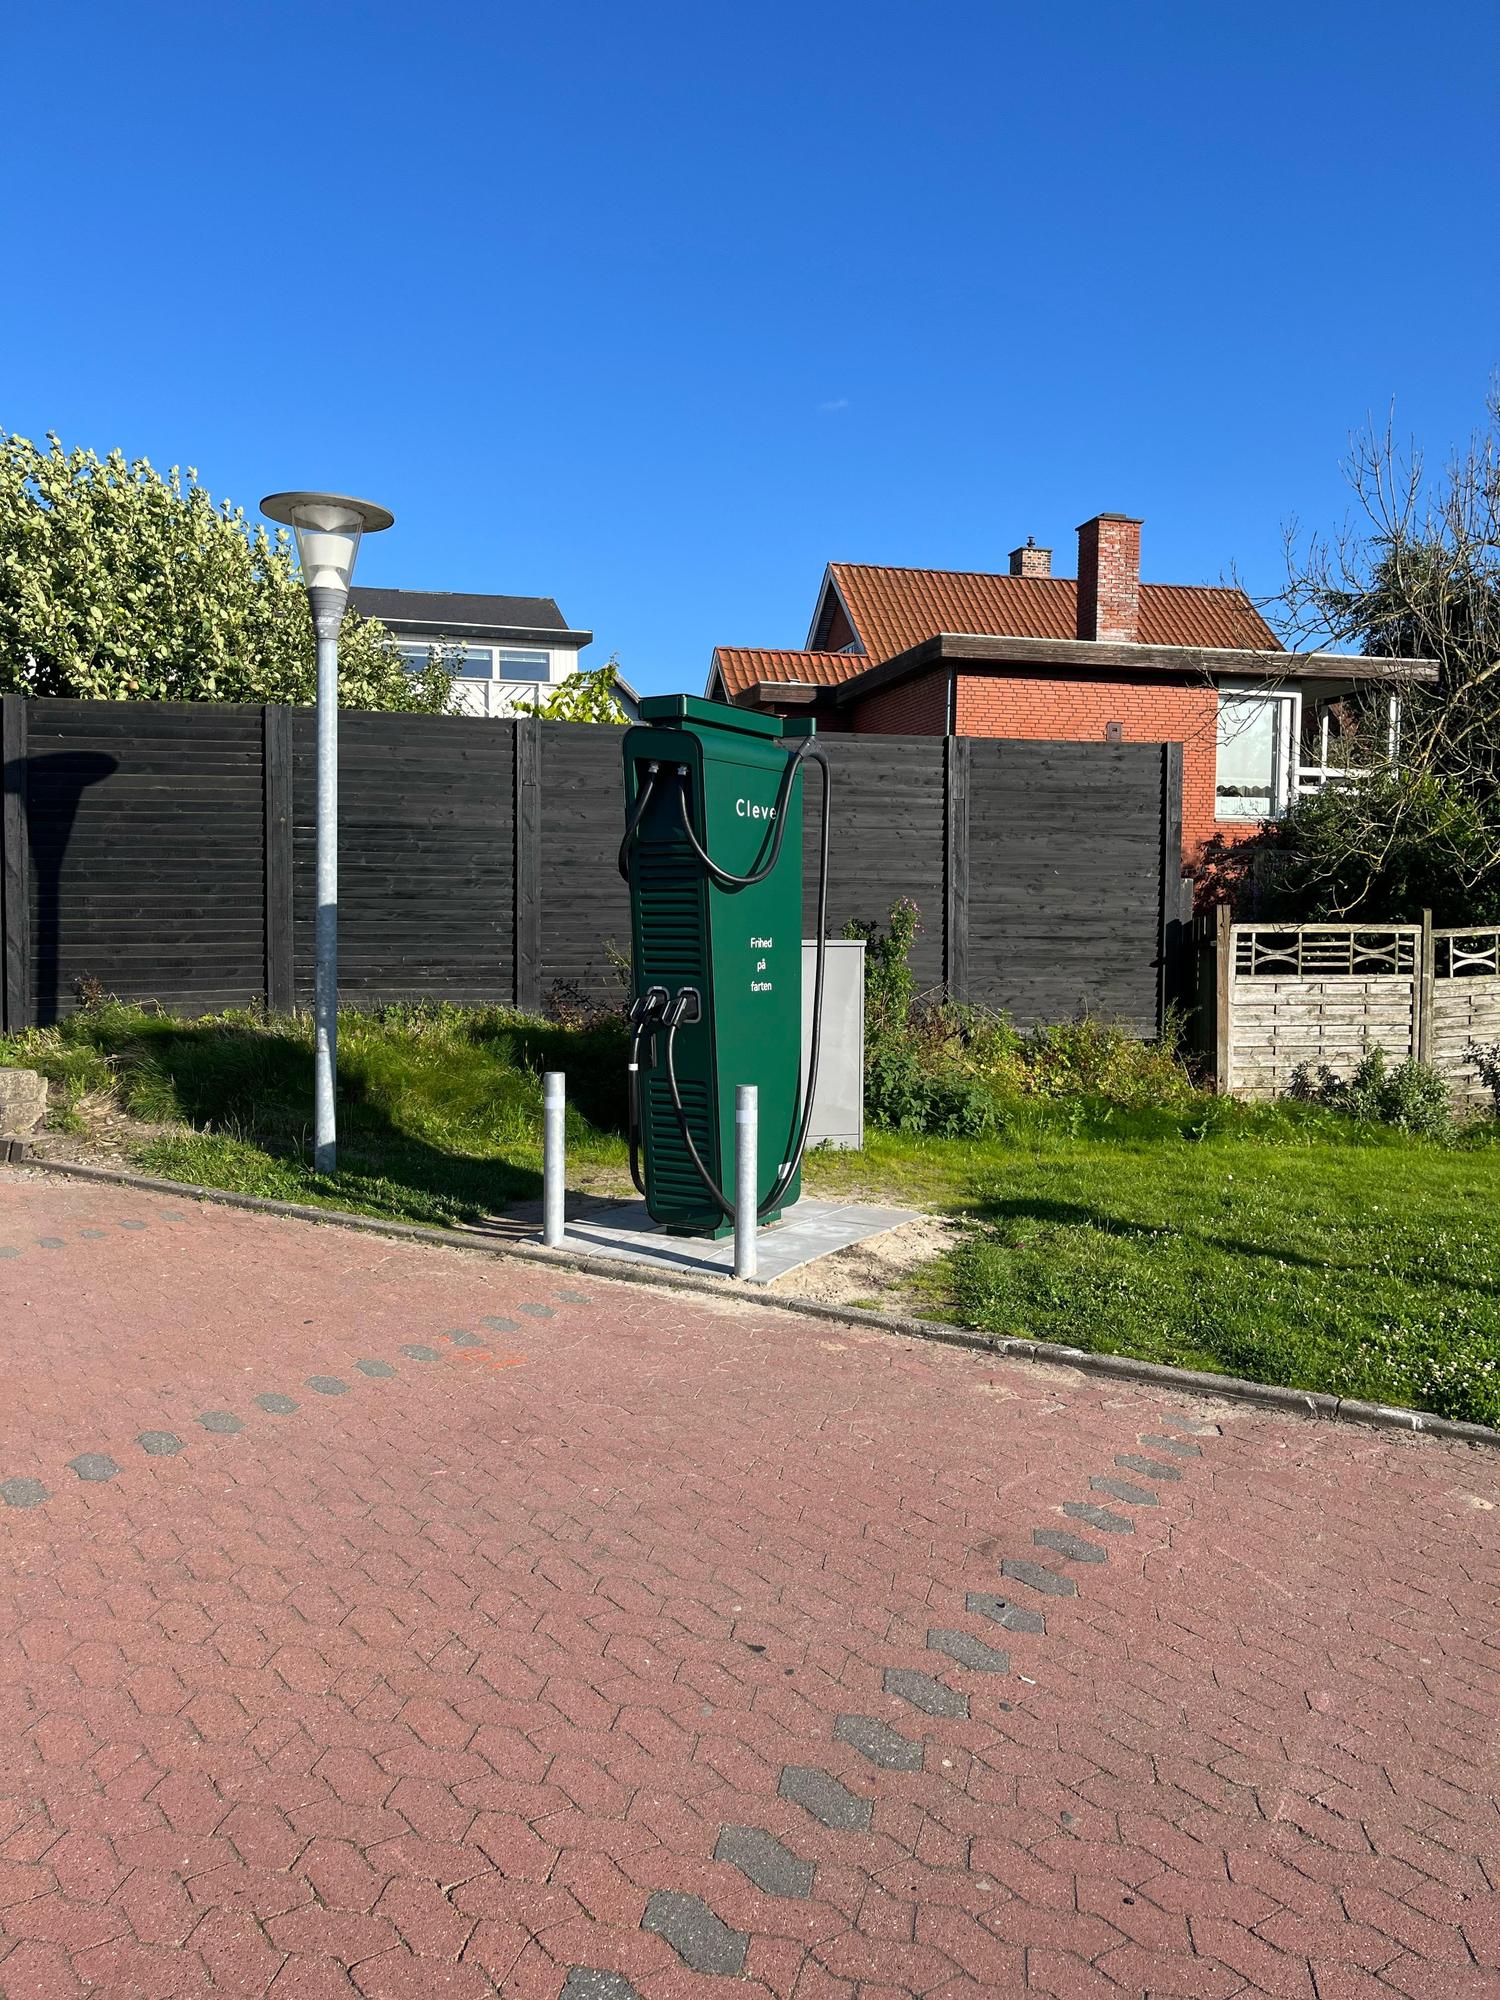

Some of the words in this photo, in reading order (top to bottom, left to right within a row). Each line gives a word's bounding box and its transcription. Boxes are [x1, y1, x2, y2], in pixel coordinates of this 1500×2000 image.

[735, 798, 777, 820] Cleve
[750, 936, 773, 949] Frihed
[757, 958, 767, 973] på
[750, 980, 773, 992] farten
